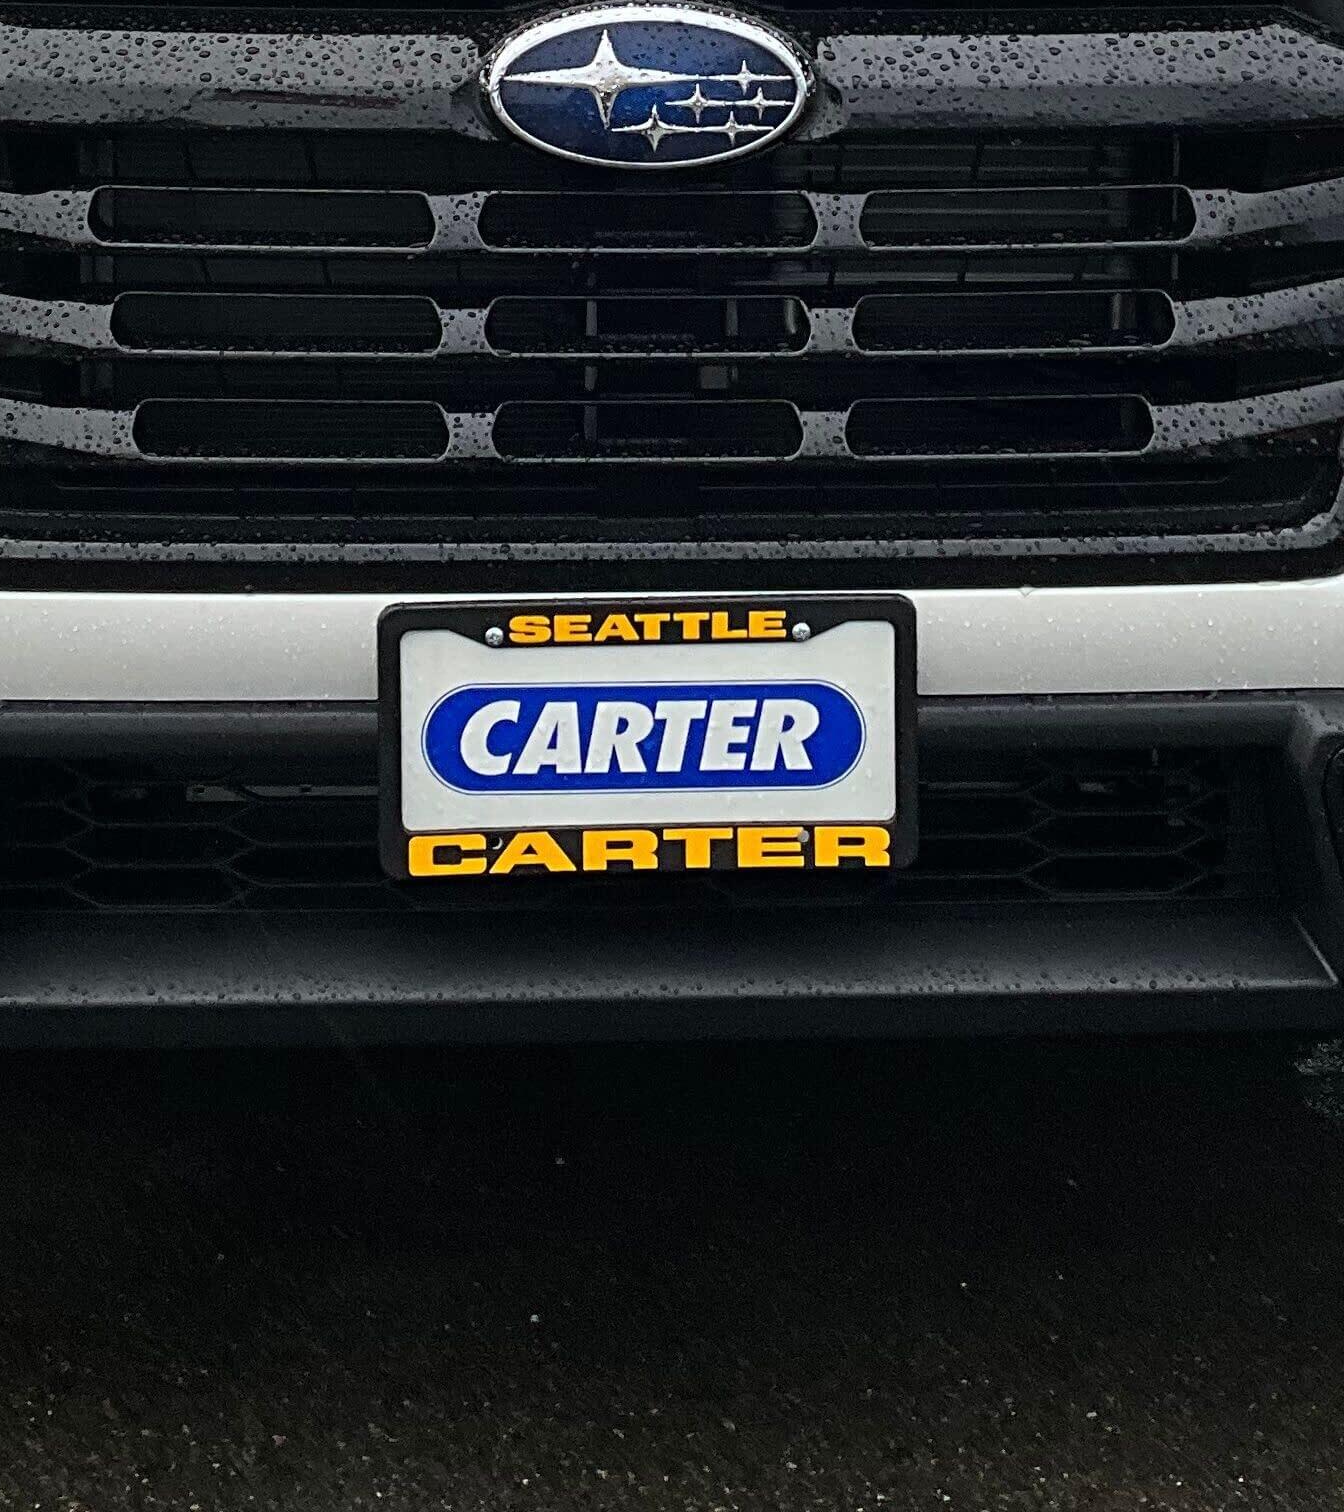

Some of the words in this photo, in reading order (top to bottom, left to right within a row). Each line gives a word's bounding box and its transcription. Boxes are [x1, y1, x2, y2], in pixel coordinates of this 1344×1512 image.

[509, 610, 787, 644] SEATTLE
[459, 699, 820, 775] CARTER
[408, 826, 891, 876] CARTER
